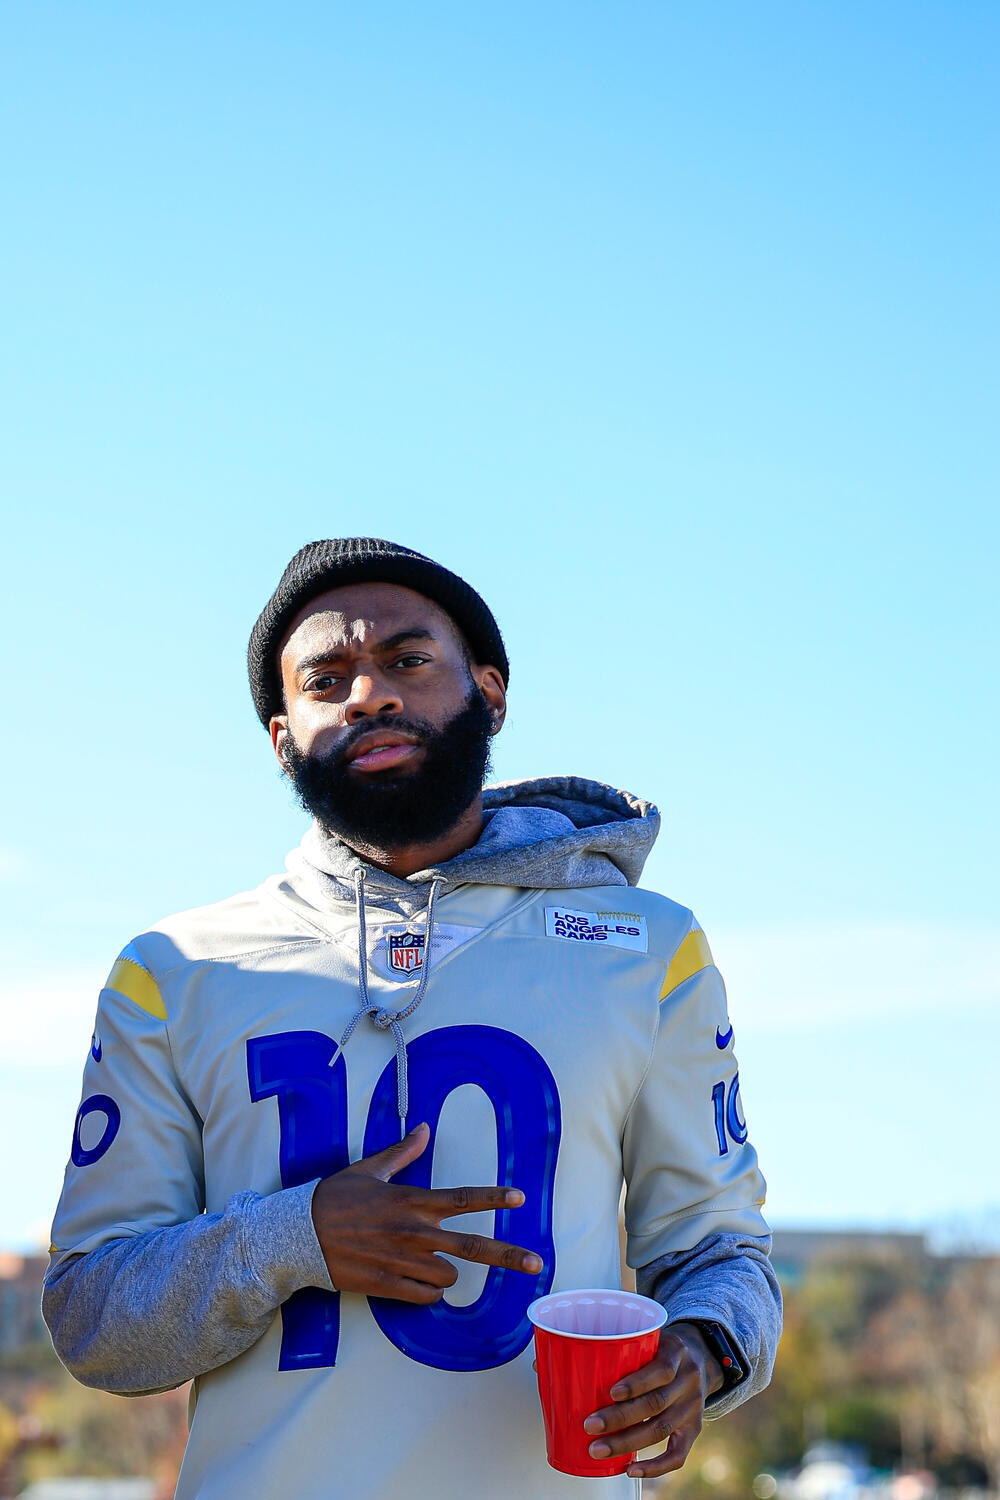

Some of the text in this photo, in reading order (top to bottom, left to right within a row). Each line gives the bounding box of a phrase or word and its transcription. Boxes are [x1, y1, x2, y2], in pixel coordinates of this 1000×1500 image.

[554, 911, 590, 926] LOS
[554, 920, 641, 936] ANGELES
[555, 927, 608, 941] RAMS
[394, 948, 423, 969] NFL
[71, 1094, 121, 1167] 0
[246, 1024, 562, 1373] 10
